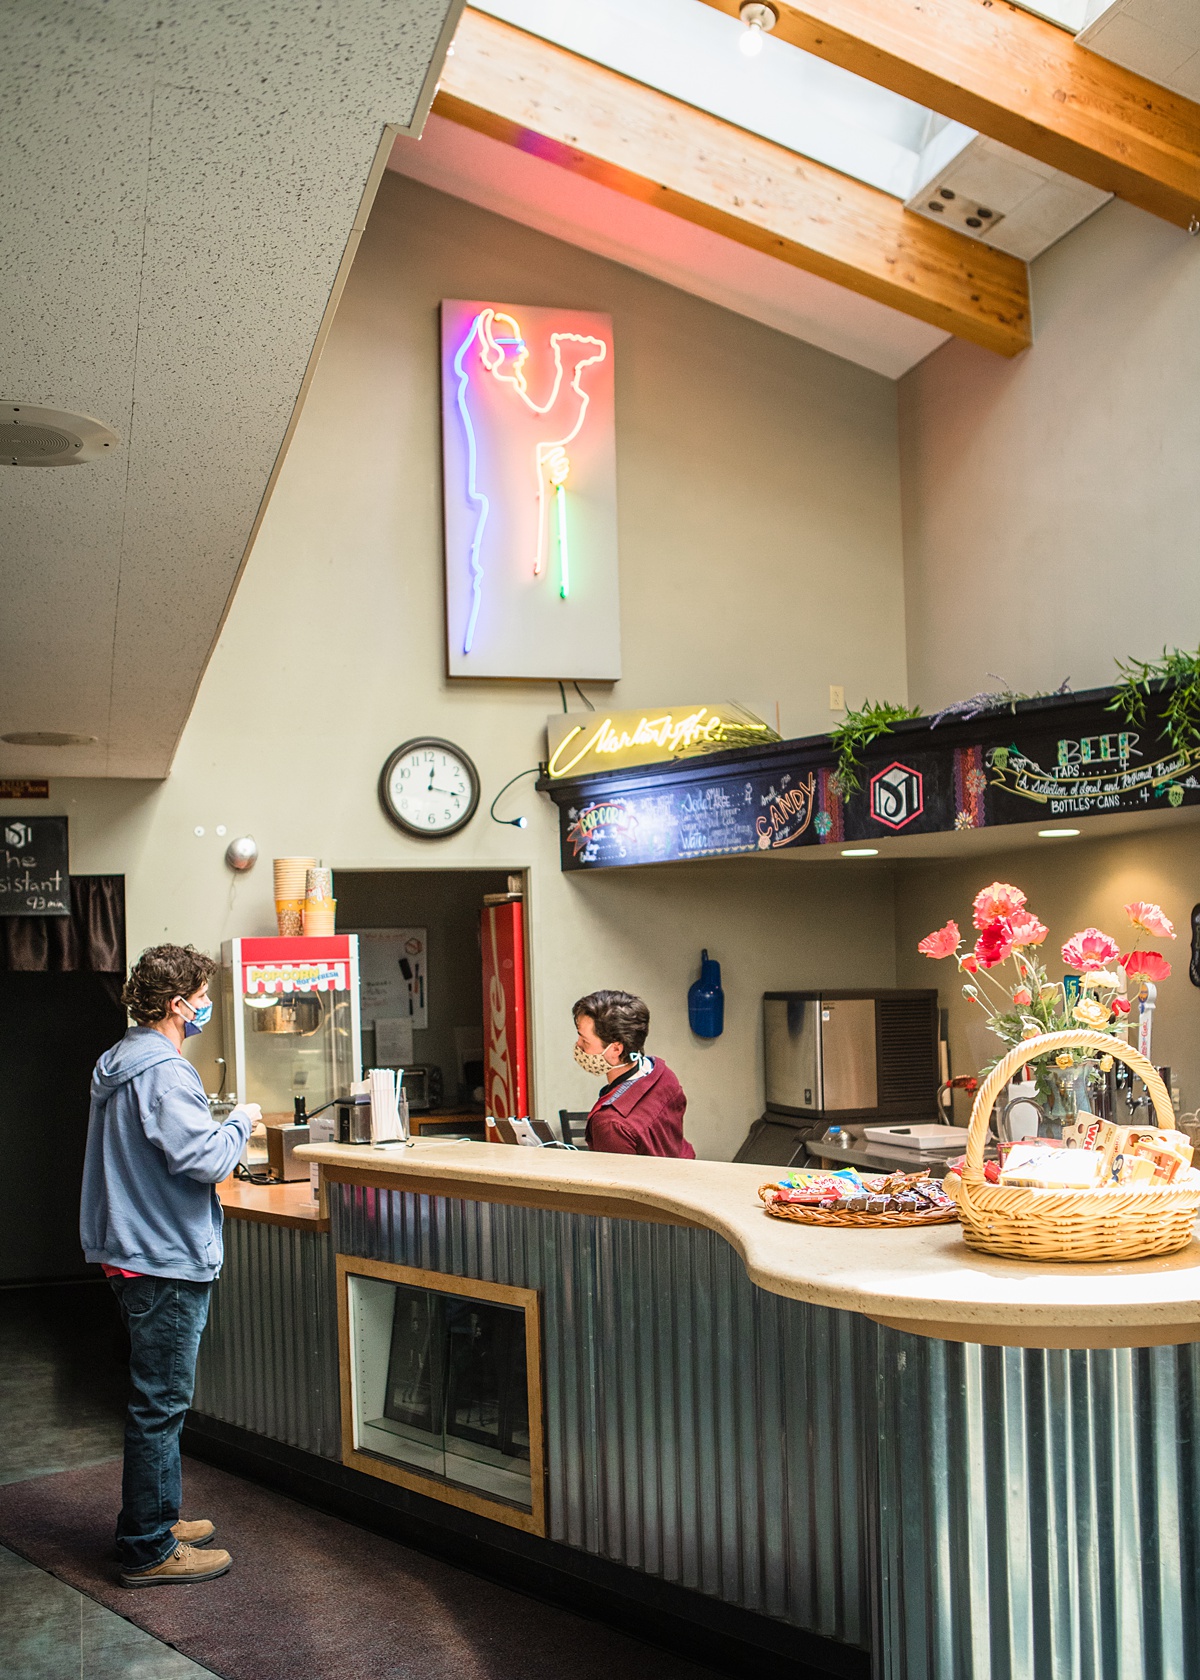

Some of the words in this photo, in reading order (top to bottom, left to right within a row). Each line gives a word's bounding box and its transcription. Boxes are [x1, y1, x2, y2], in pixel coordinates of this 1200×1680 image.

[1057, 731, 1144, 766] BEER
[411, 756, 419, 766] 11
[424, 751, 434, 762] 12
[442, 756, 445, 766] 1
[400, 768, 410, 778] 10
[453, 766, 459, 776] 2
[1018, 774, 1029, 790] A
[1103, 775, 1120, 792] and
[1121, 766, 1154, 789] Regional
[395, 783, 403, 793] 9
[458, 782, 465, 792] 3
[1140, 787, 1150, 804] 4
[428, 813, 435, 823] 6
[444, 809, 451, 819] 5
[580, 806, 632, 835] POPCORN
[0, 850, 36, 866] he
[619, 846, 628, 859] 5
[26, 896, 46, 911] 93
[252, 968, 319, 982] POPCORN
[296, 977, 310, 986] HOT
[318, 971, 339, 980] FRESH
